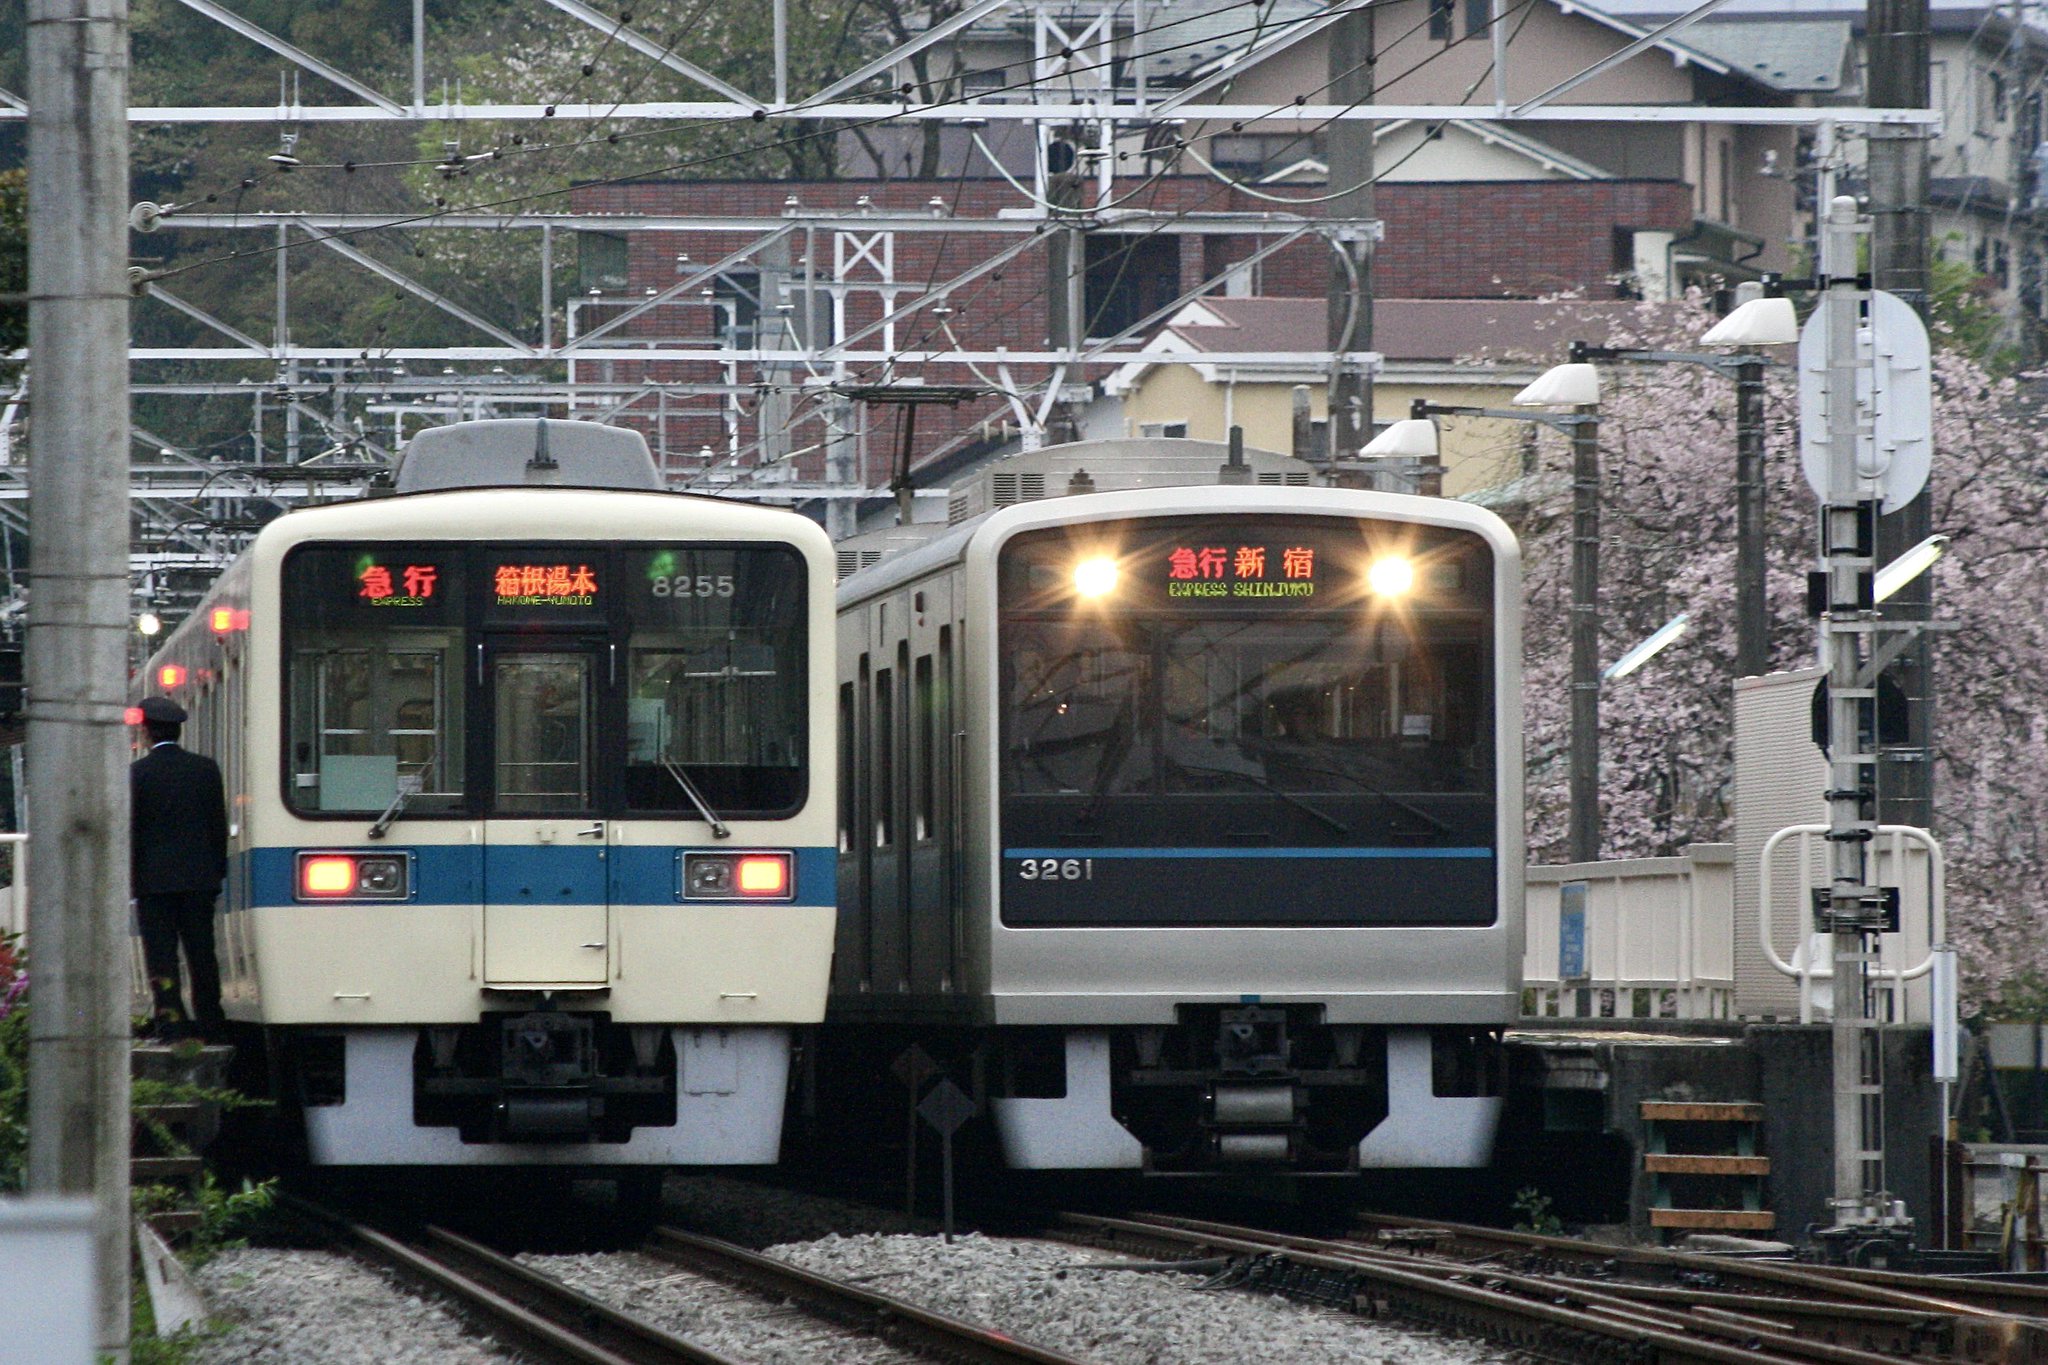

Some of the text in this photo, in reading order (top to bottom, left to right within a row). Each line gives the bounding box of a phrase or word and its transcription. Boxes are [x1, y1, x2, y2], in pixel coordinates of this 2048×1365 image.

[1168, 547, 1314, 579] 急行 新宿
[358, 566, 437, 598] 急行
[494, 566, 598, 596] 箱根湯本
[652, 575, 735, 598] 8255
[1168, 582, 1314, 597] EXPRESS SHINJUKU
[371, 596, 423, 607] EXPRESS
[497, 595, 593, 606] HAKONE-YUMOTO
[1019, 858, 1092, 880] 3261
